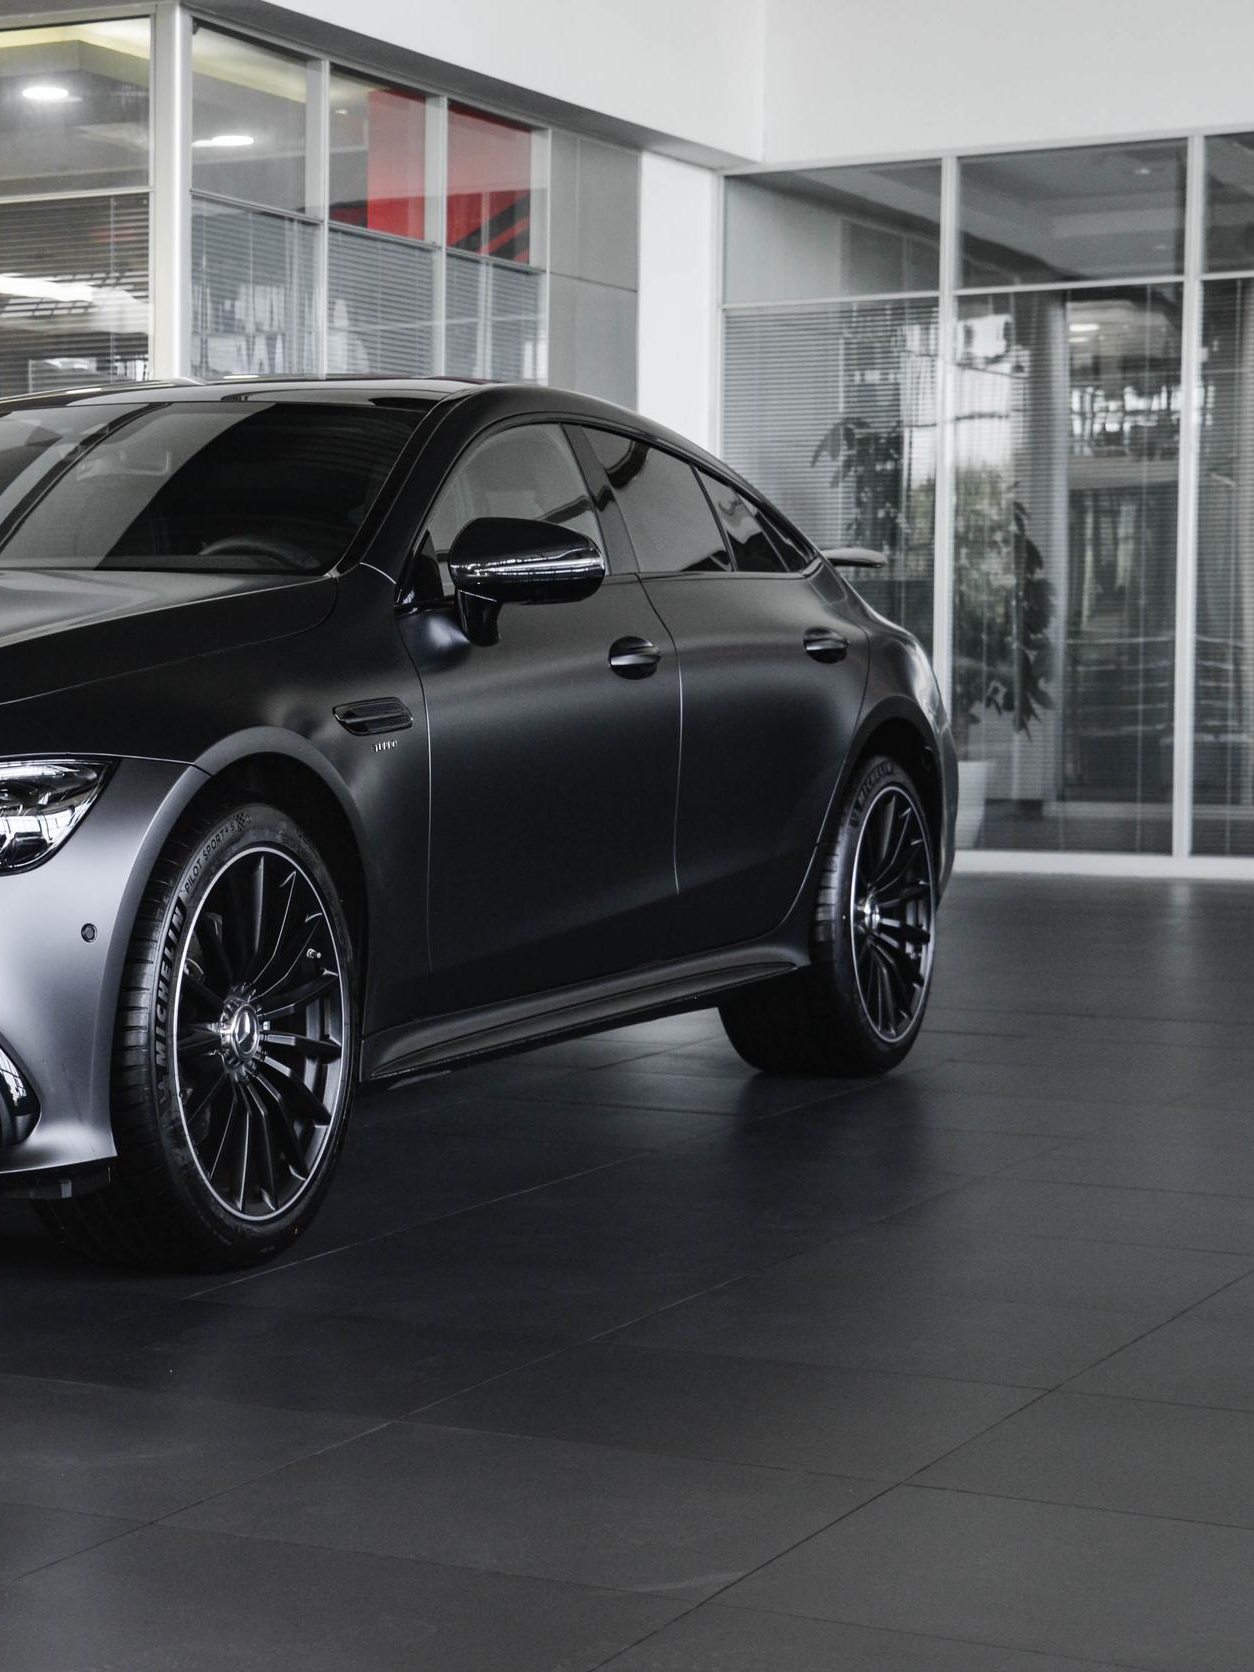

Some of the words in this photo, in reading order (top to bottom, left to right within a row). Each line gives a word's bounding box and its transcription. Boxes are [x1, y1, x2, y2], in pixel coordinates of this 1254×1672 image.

[184, 858, 202, 894] PILOT
[202, 829, 224, 861] SPORT
[155, 897, 186, 1069] MICHELIN
